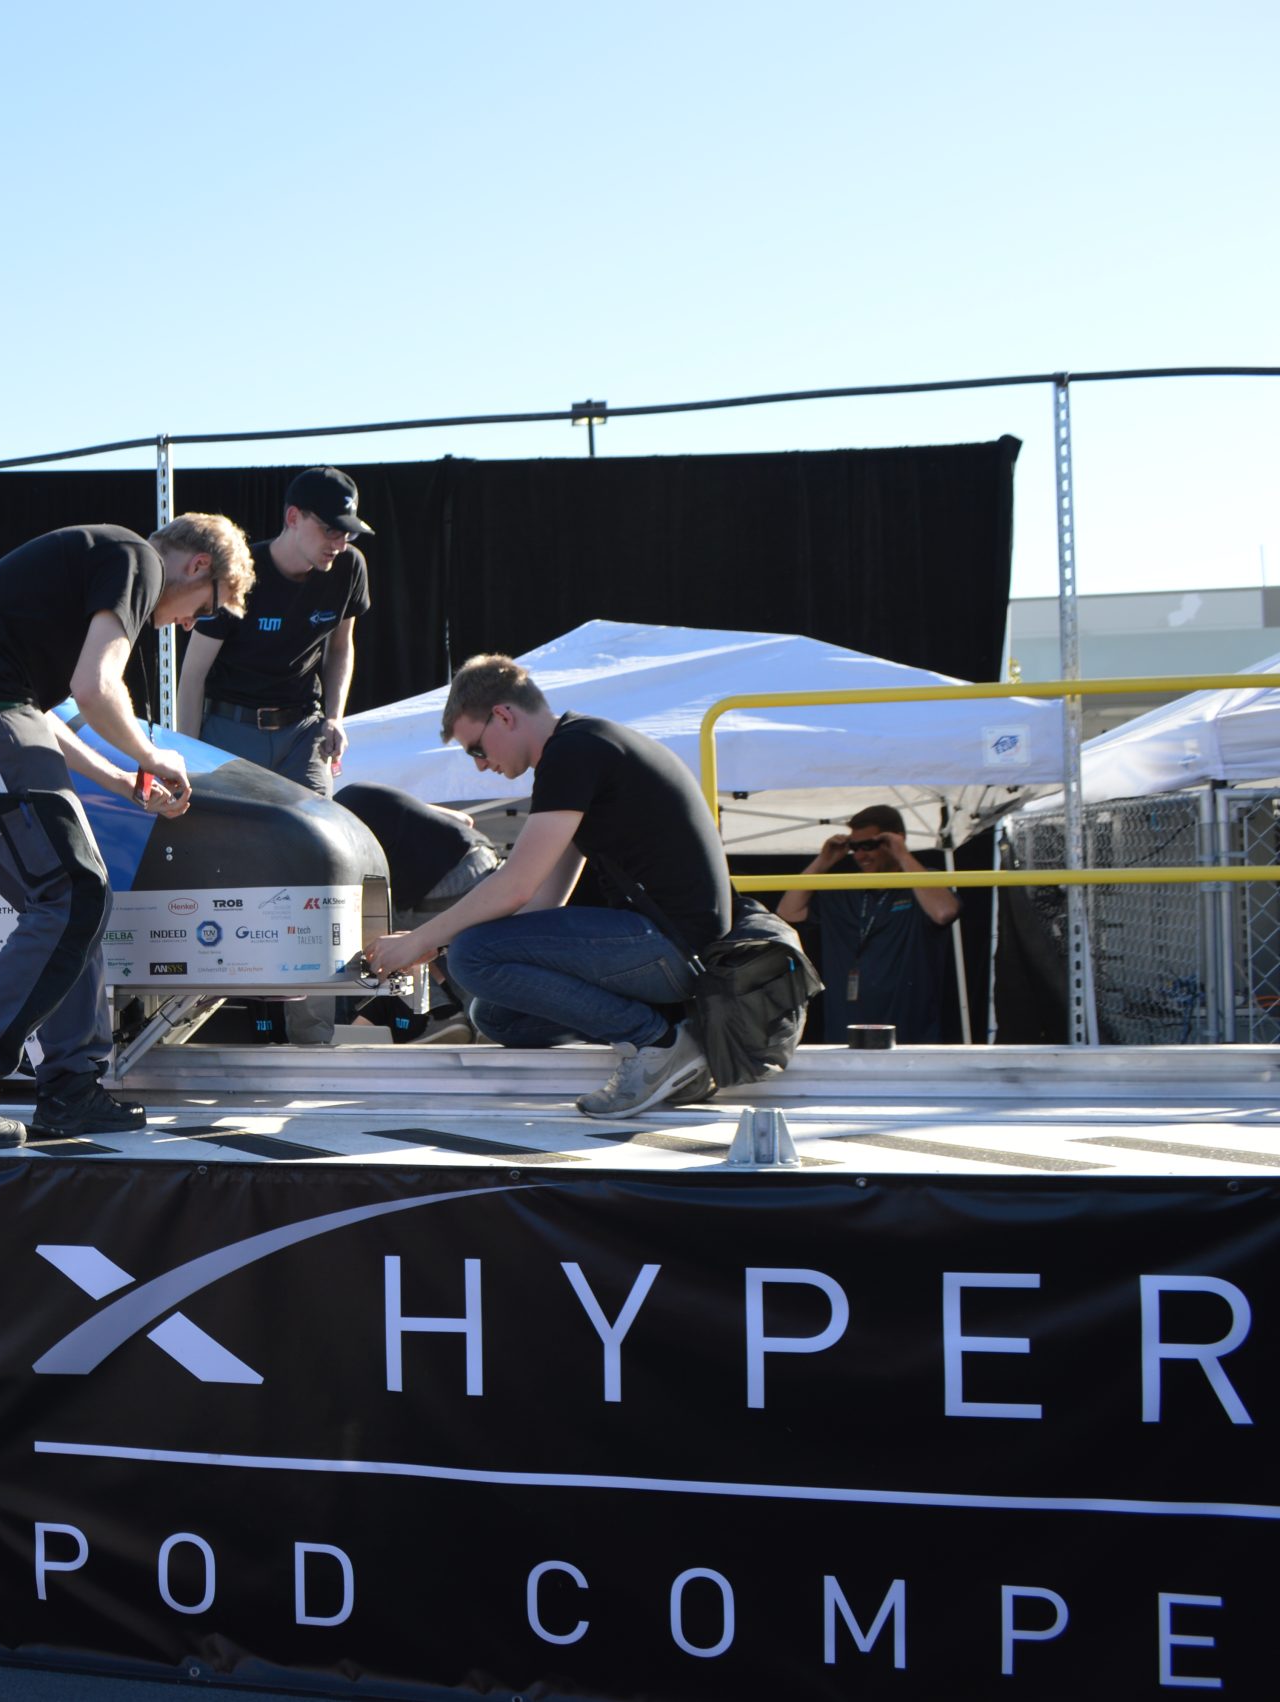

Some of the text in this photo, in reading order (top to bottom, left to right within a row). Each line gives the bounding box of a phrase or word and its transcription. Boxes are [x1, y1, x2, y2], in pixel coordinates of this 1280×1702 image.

[170, 902, 196, 911] Henkel
[212, 899, 244, 909] TROB
[150, 929, 187, 939] INDEED
[235, 926, 279, 939] GLEICH
[297, 926, 311, 935] tech
[154, 963, 184, 973] ANSYS
[383, 1255, 1254, 1424] HYPER
[34, 1522, 1223, 1688] POD COMPE
